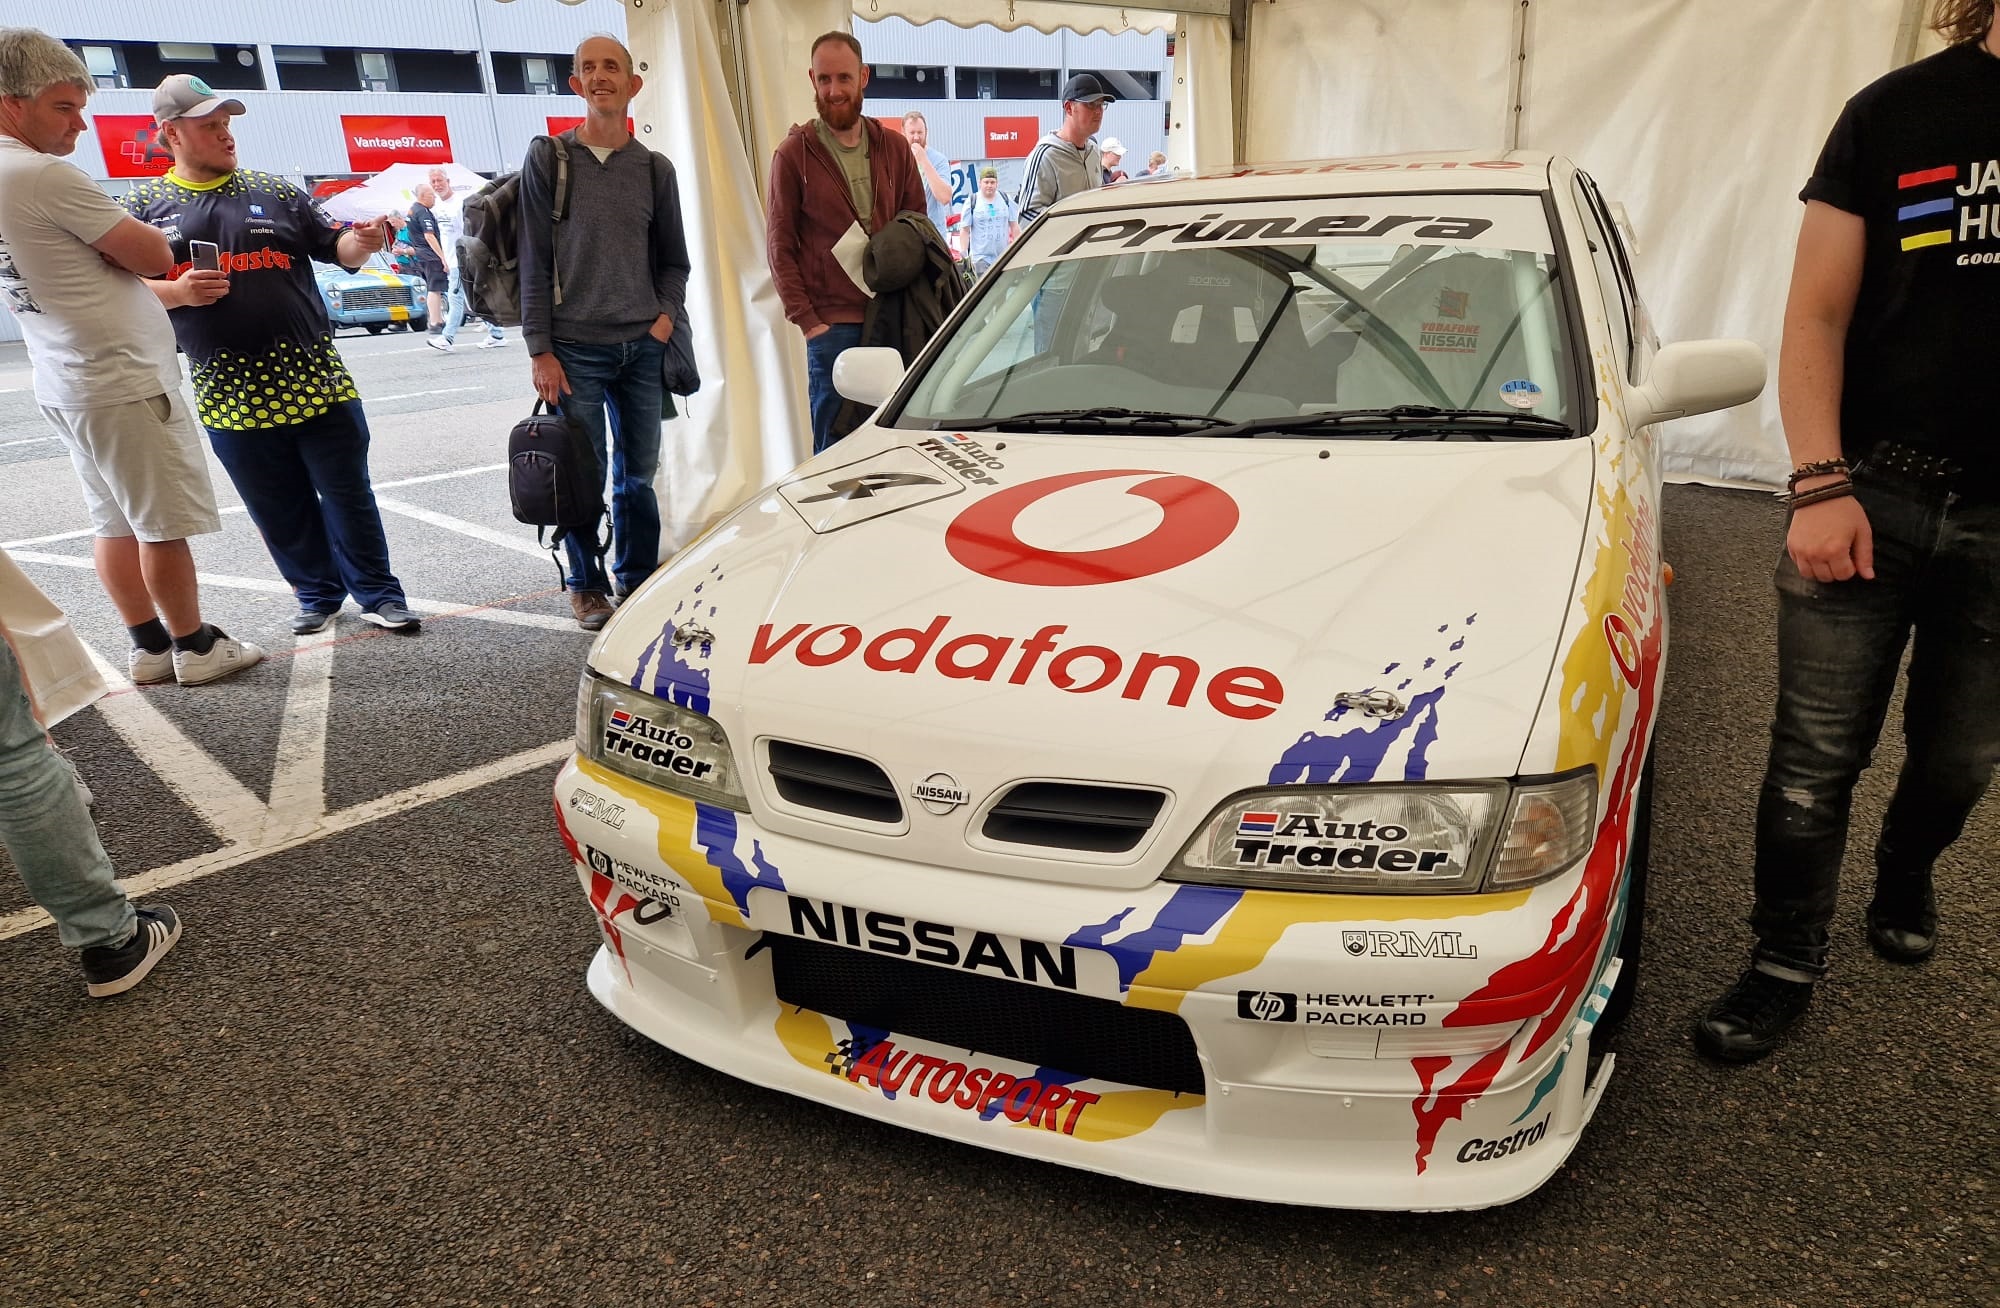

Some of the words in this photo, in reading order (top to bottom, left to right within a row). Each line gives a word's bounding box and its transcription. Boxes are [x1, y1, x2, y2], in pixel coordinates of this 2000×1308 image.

[353, 136, 444, 150] Vantage97.com
[989, 131, 1009, 141] Stand
[1010, 131, 1018, 140] 21
[250, 227, 275, 235] molex
[1048, 213, 1495, 257] Primera
[1419, 335, 1477, 349] NISSAN
[917, 438, 1000, 486] Trader
[951, 441, 1005, 470] Auto
[748, 615, 1284, 720] vodafone
[625, 716, 693, 750] Auto
[605, 730, 713, 779] Trader
[916, 785, 962, 801] NISSAN
[577, 792, 626, 831] RML
[1275, 814, 1408, 842] Auto
[1234, 839, 1449, 872] Trader
[614, 858, 677, 891] HEWLETT
[617, 874, 681, 907] PACKARD
[787, 894, 1078, 990] NISSAN
[1370, 930, 1478, 959] RML
[1305, 992, 1428, 1008] HEWLETT
[1305, 1010, 1427, 1026] PACKARD
[849, 1041, 1101, 1135] AUTOSPORT
[1456, 1112, 1552, 1164] Castrol
